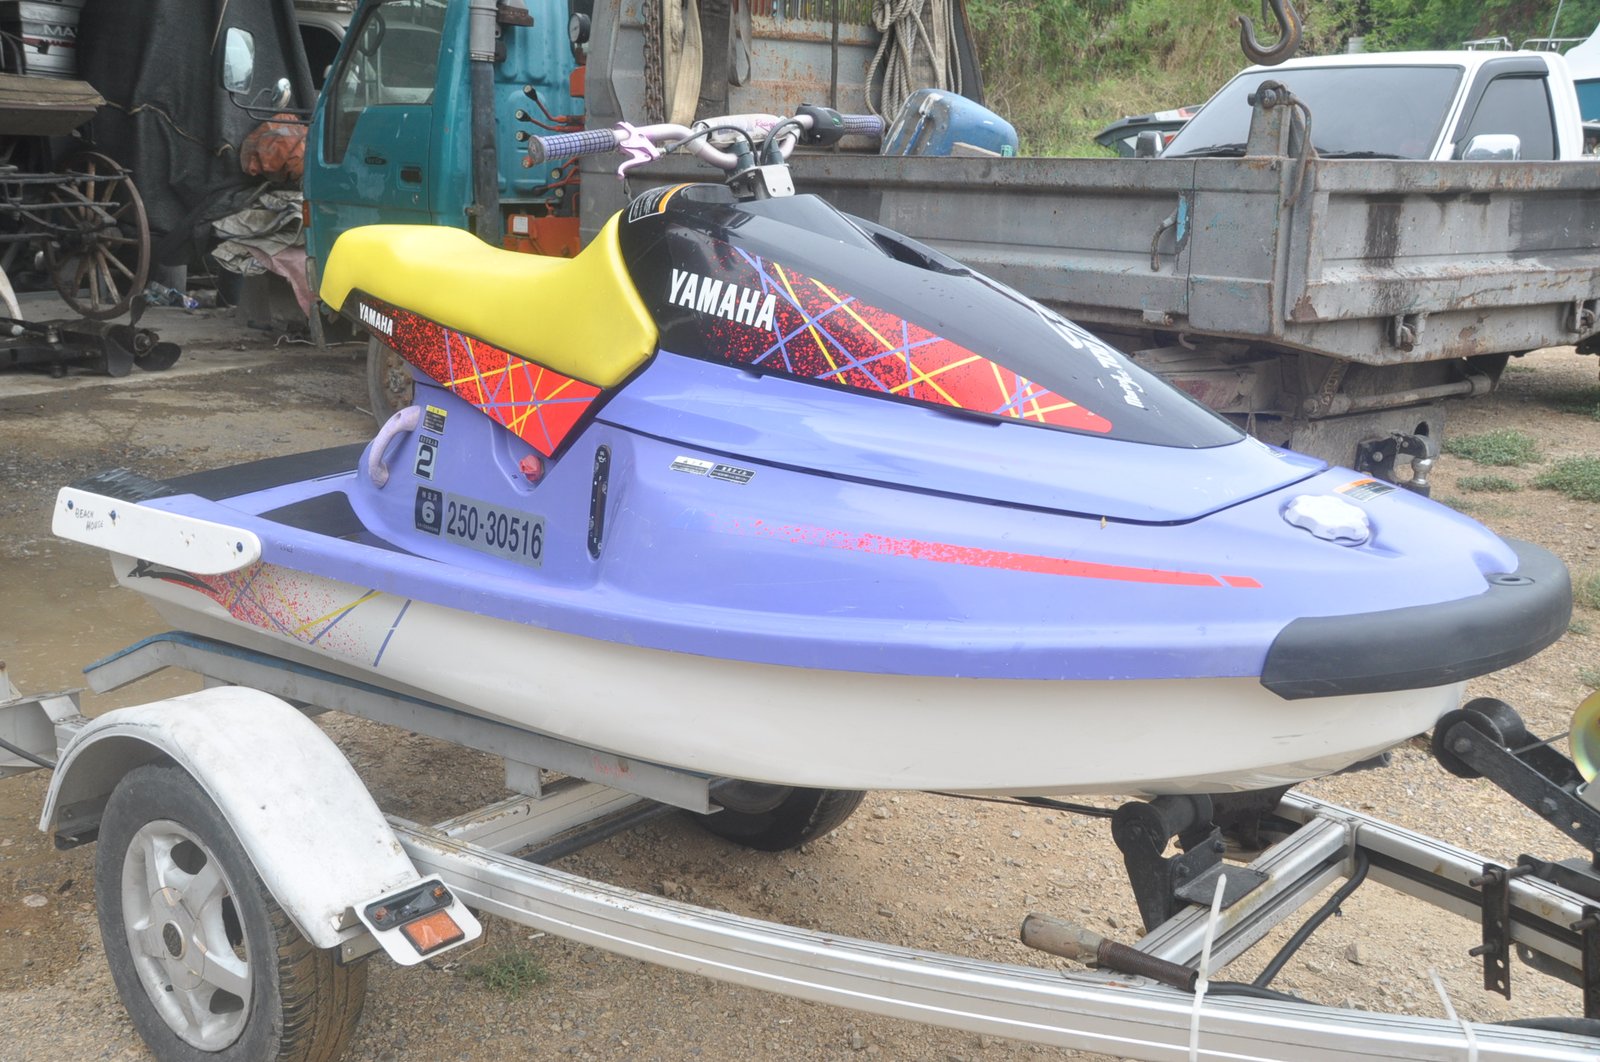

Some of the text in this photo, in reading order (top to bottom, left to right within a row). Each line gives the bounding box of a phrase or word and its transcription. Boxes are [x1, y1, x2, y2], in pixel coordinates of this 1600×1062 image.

[669, 268, 777, 332] YAMAHA
[360, 302, 393, 337] YAMAHA
[416, 444, 434, 478] 2
[421, 501, 436, 524] 6
[446, 501, 542, 560] 250-30516
